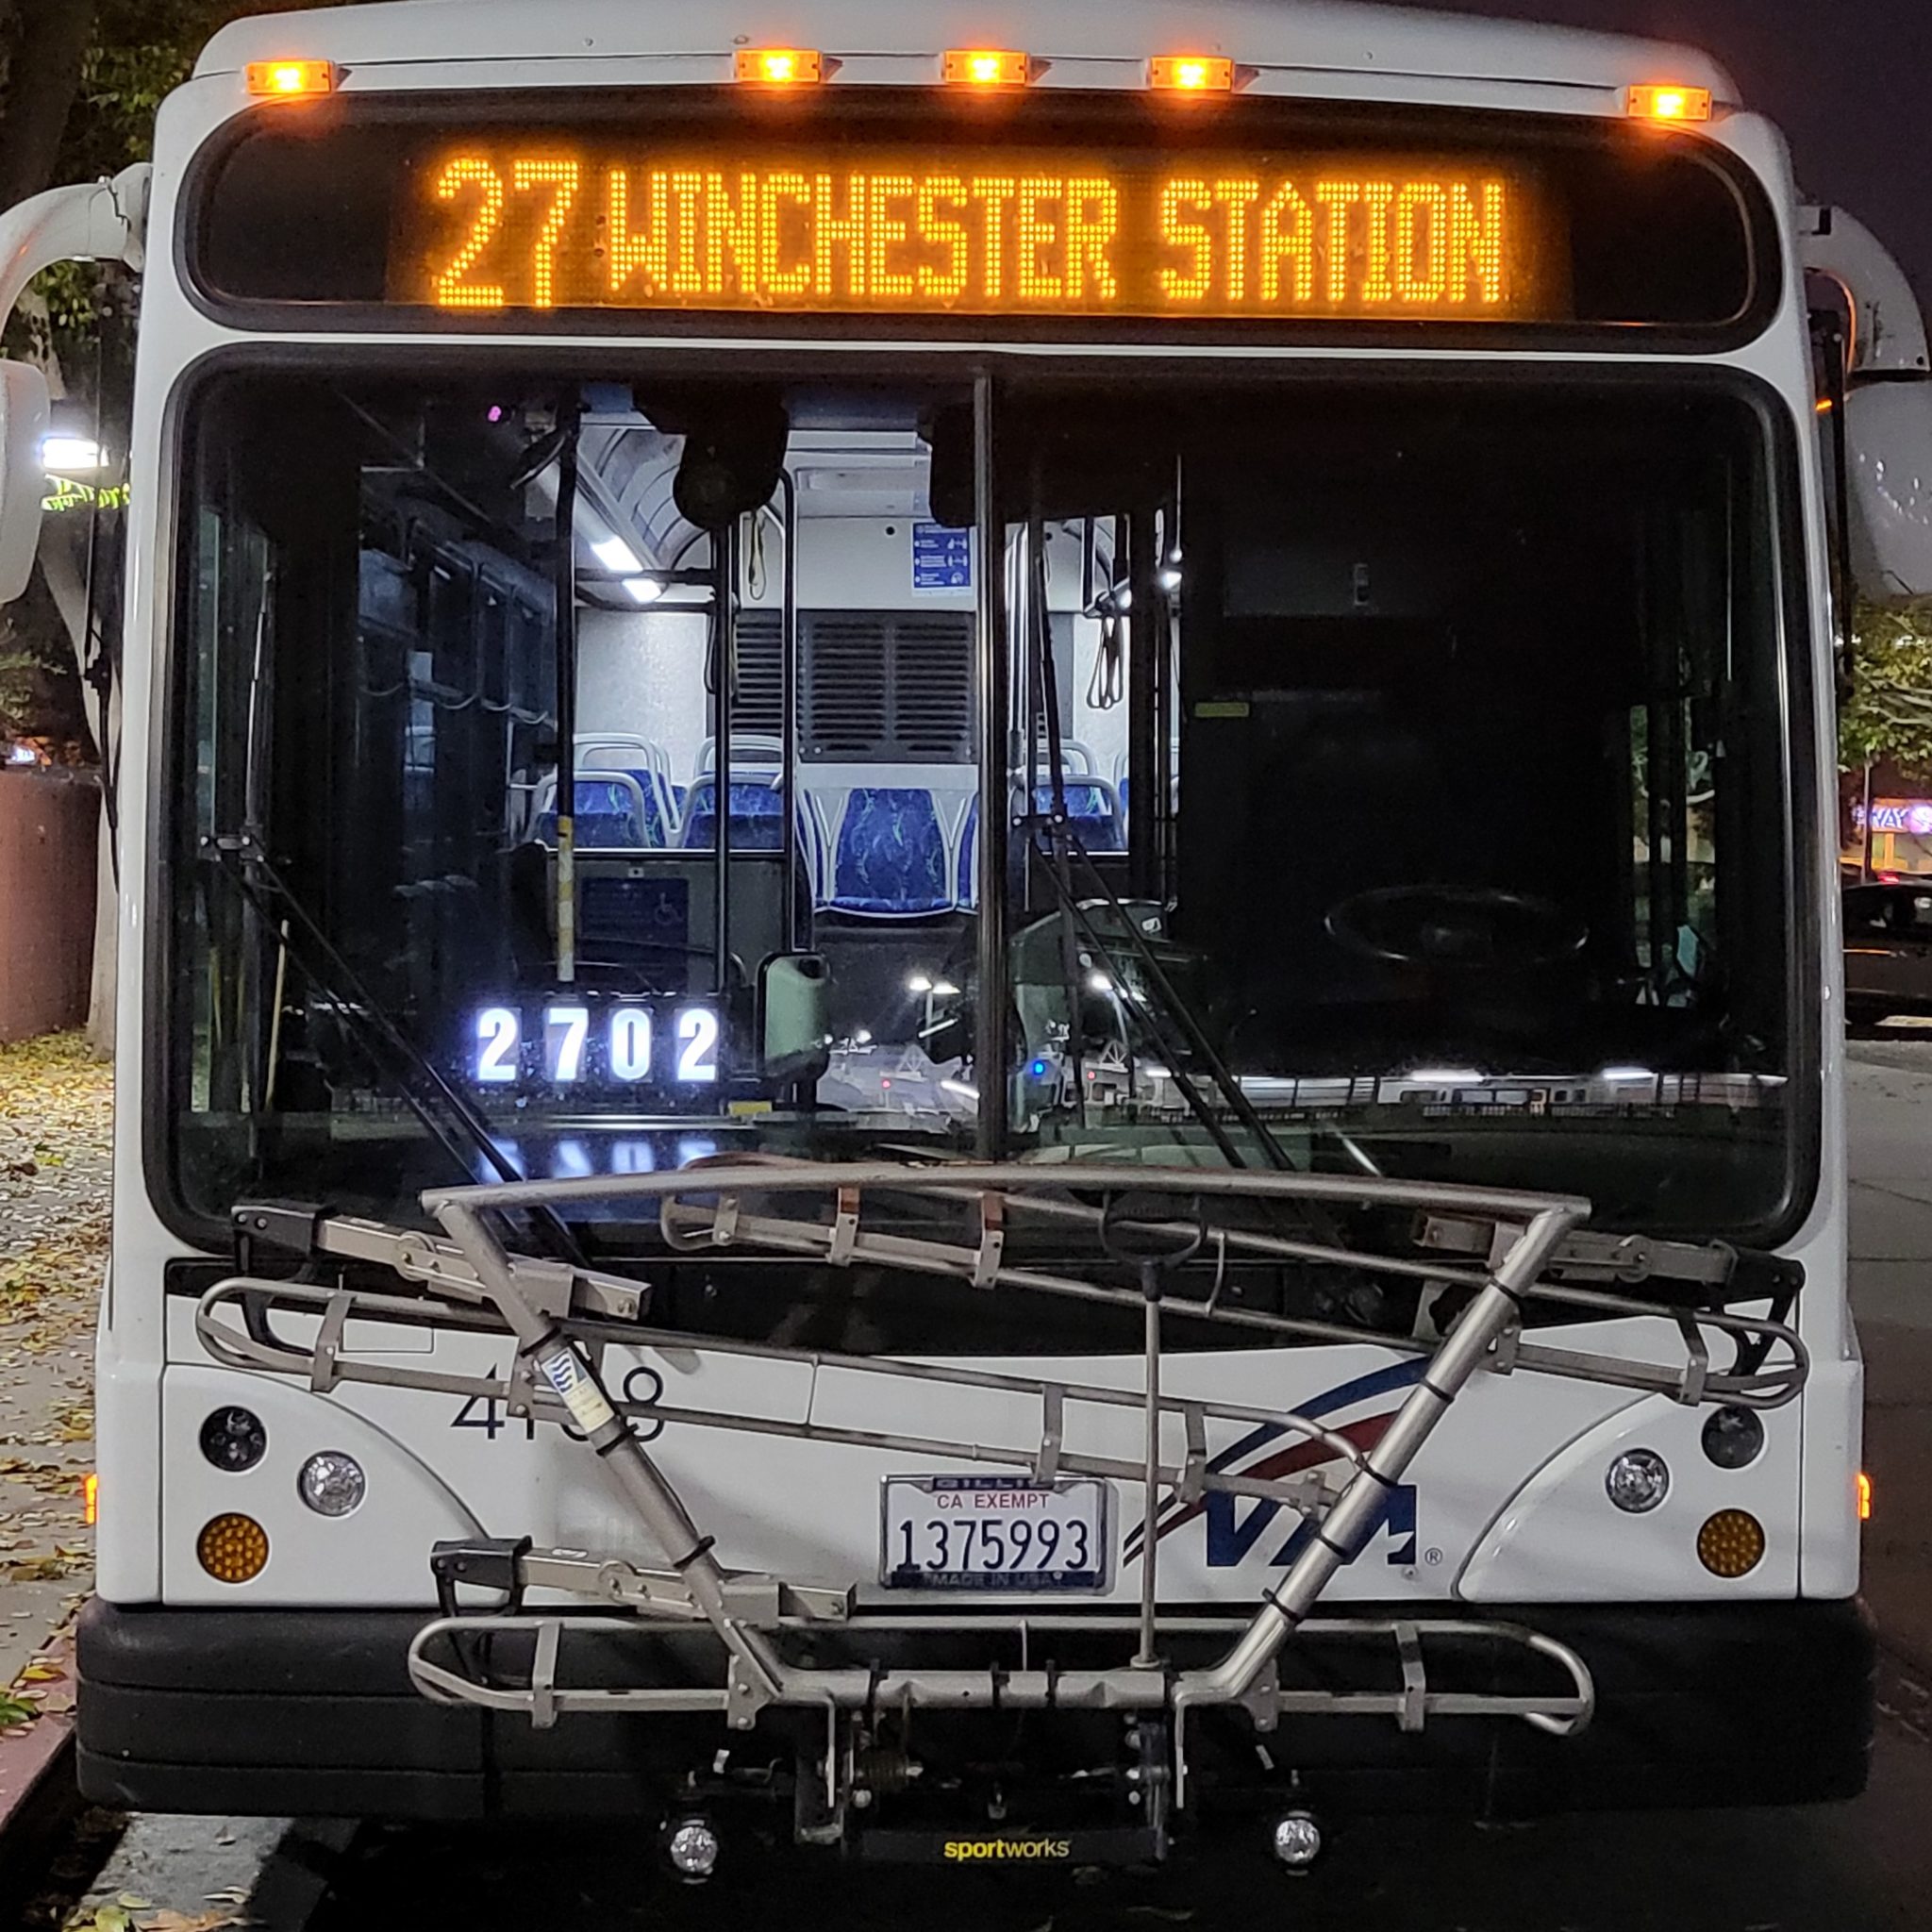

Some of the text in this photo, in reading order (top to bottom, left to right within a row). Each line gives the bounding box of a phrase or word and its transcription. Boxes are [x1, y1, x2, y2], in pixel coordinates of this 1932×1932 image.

[436, 158, 1504, 308] 27 WINCHESTER STATION
[478, 1008, 717, 1081] 2702
[937, 1494, 1050, 1508] CA EXEMPT
[897, 1520, 1089, 1571] 1375993
[932, 1573, 1051, 1587] MADE IN USA
[944, 1838, 1071, 1861] sportworks
